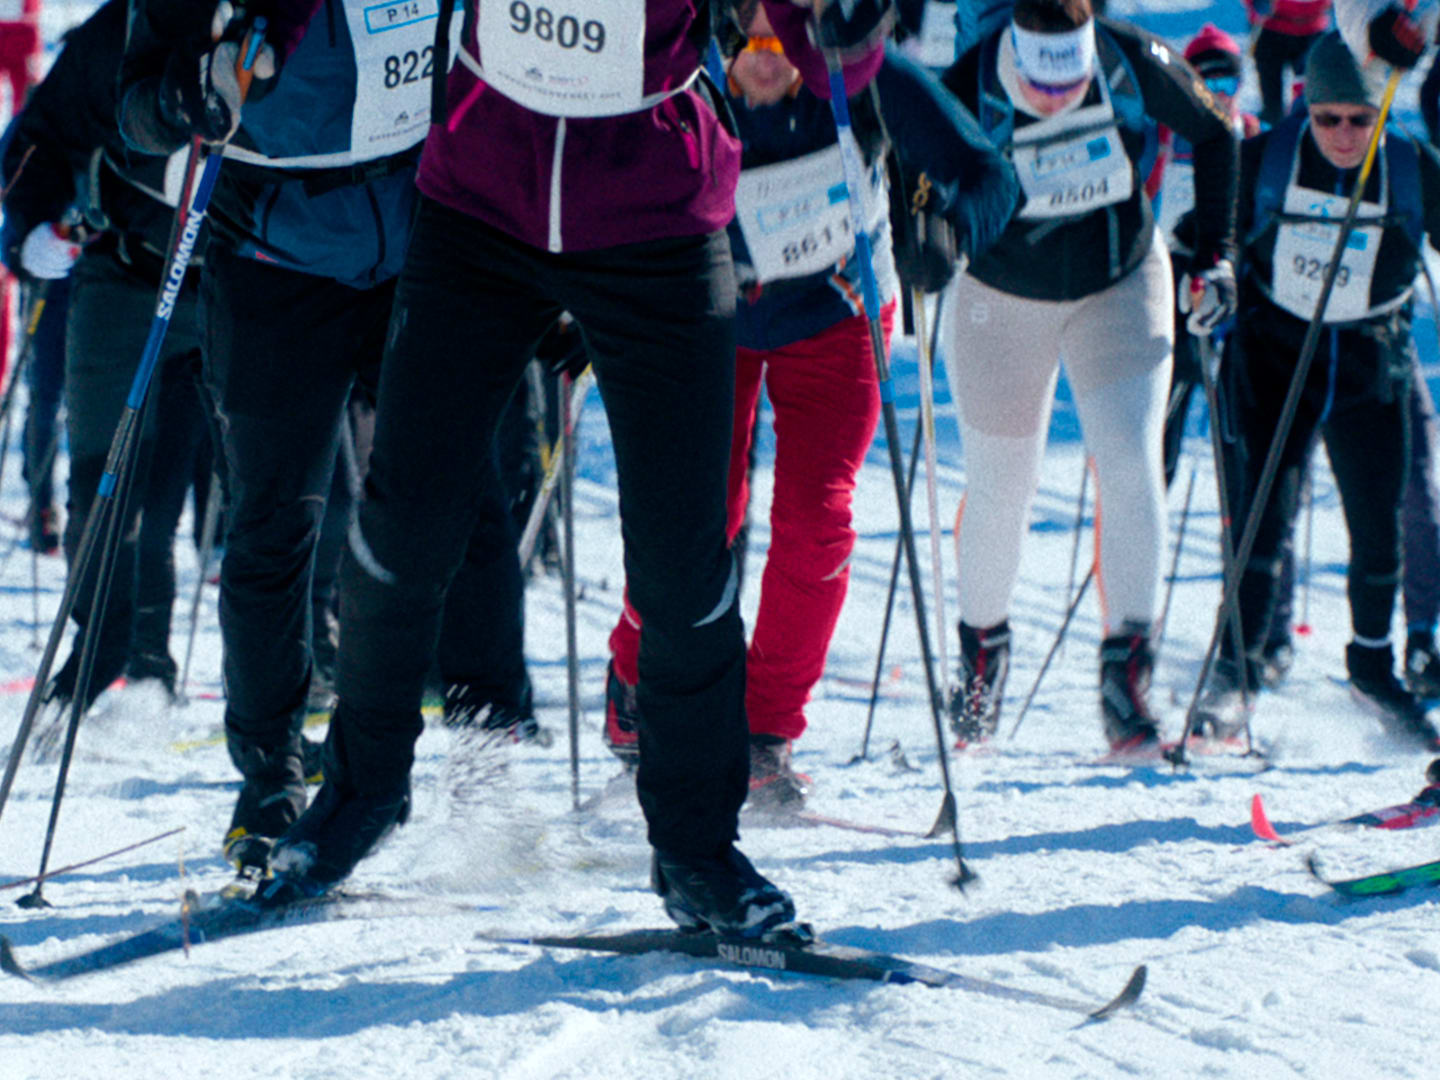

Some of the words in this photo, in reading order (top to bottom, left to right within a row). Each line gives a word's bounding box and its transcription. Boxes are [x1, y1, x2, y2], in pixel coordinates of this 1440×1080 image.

[386, 7, 398, 23] P
[403, 2, 420, 20] 14
[509, 0, 606, 54] 9809
[383, 44, 435, 90] 822
[156, 206, 208, 321] SALOMON
[782, 217, 850, 264] 8611
[717, 942, 787, 970] SALOMON
